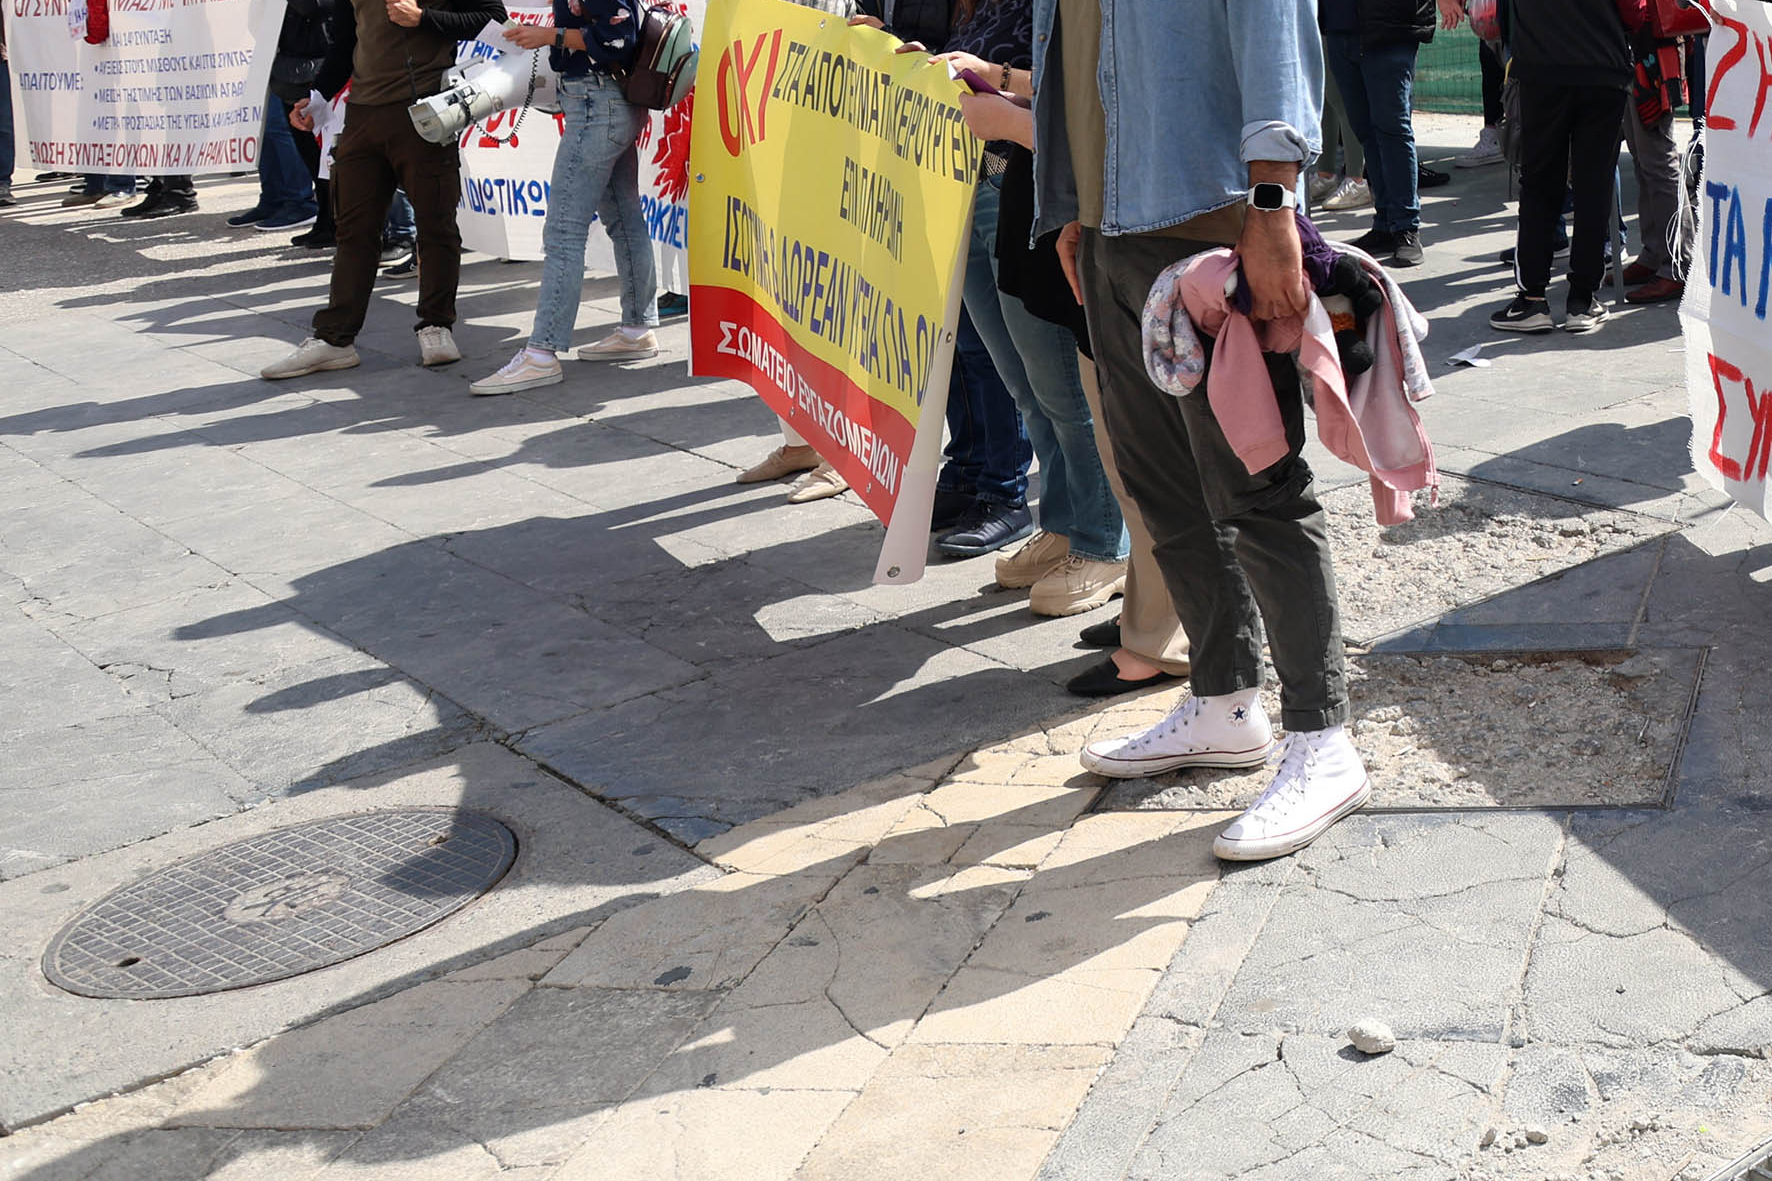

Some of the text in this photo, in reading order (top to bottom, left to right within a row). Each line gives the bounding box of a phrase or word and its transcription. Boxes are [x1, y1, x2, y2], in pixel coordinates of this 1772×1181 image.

[30, 141, 65, 165] ΕΝΩΣΗ
[68, 142, 159, 168] ΣΥΝΤΑΞΙΟΥΧΩΝ
[161, 143, 181, 168] ΙΚΑ
[199, 136, 260, 166] ΗΡΑΚΛΕΙΟ
[165, 86, 183, 101] ΤΩΝ
[716, 28, 783, 158] ΟΧΙ
[772, 41, 810, 106] ΣΤΑ
[1705, 181, 1748, 307] ΤΑ
[781, 235, 851, 348] ΔΩΡΕΑΝ
[849, 269, 881, 379] ΥΓΕΙΑ
[883, 296, 913, 398] ΓΙΑ
[716, 320, 899, 495] ΣΩΜΑΤΕΙΟ ΕΡΓΑΖΟΜΕΝΩΝ
